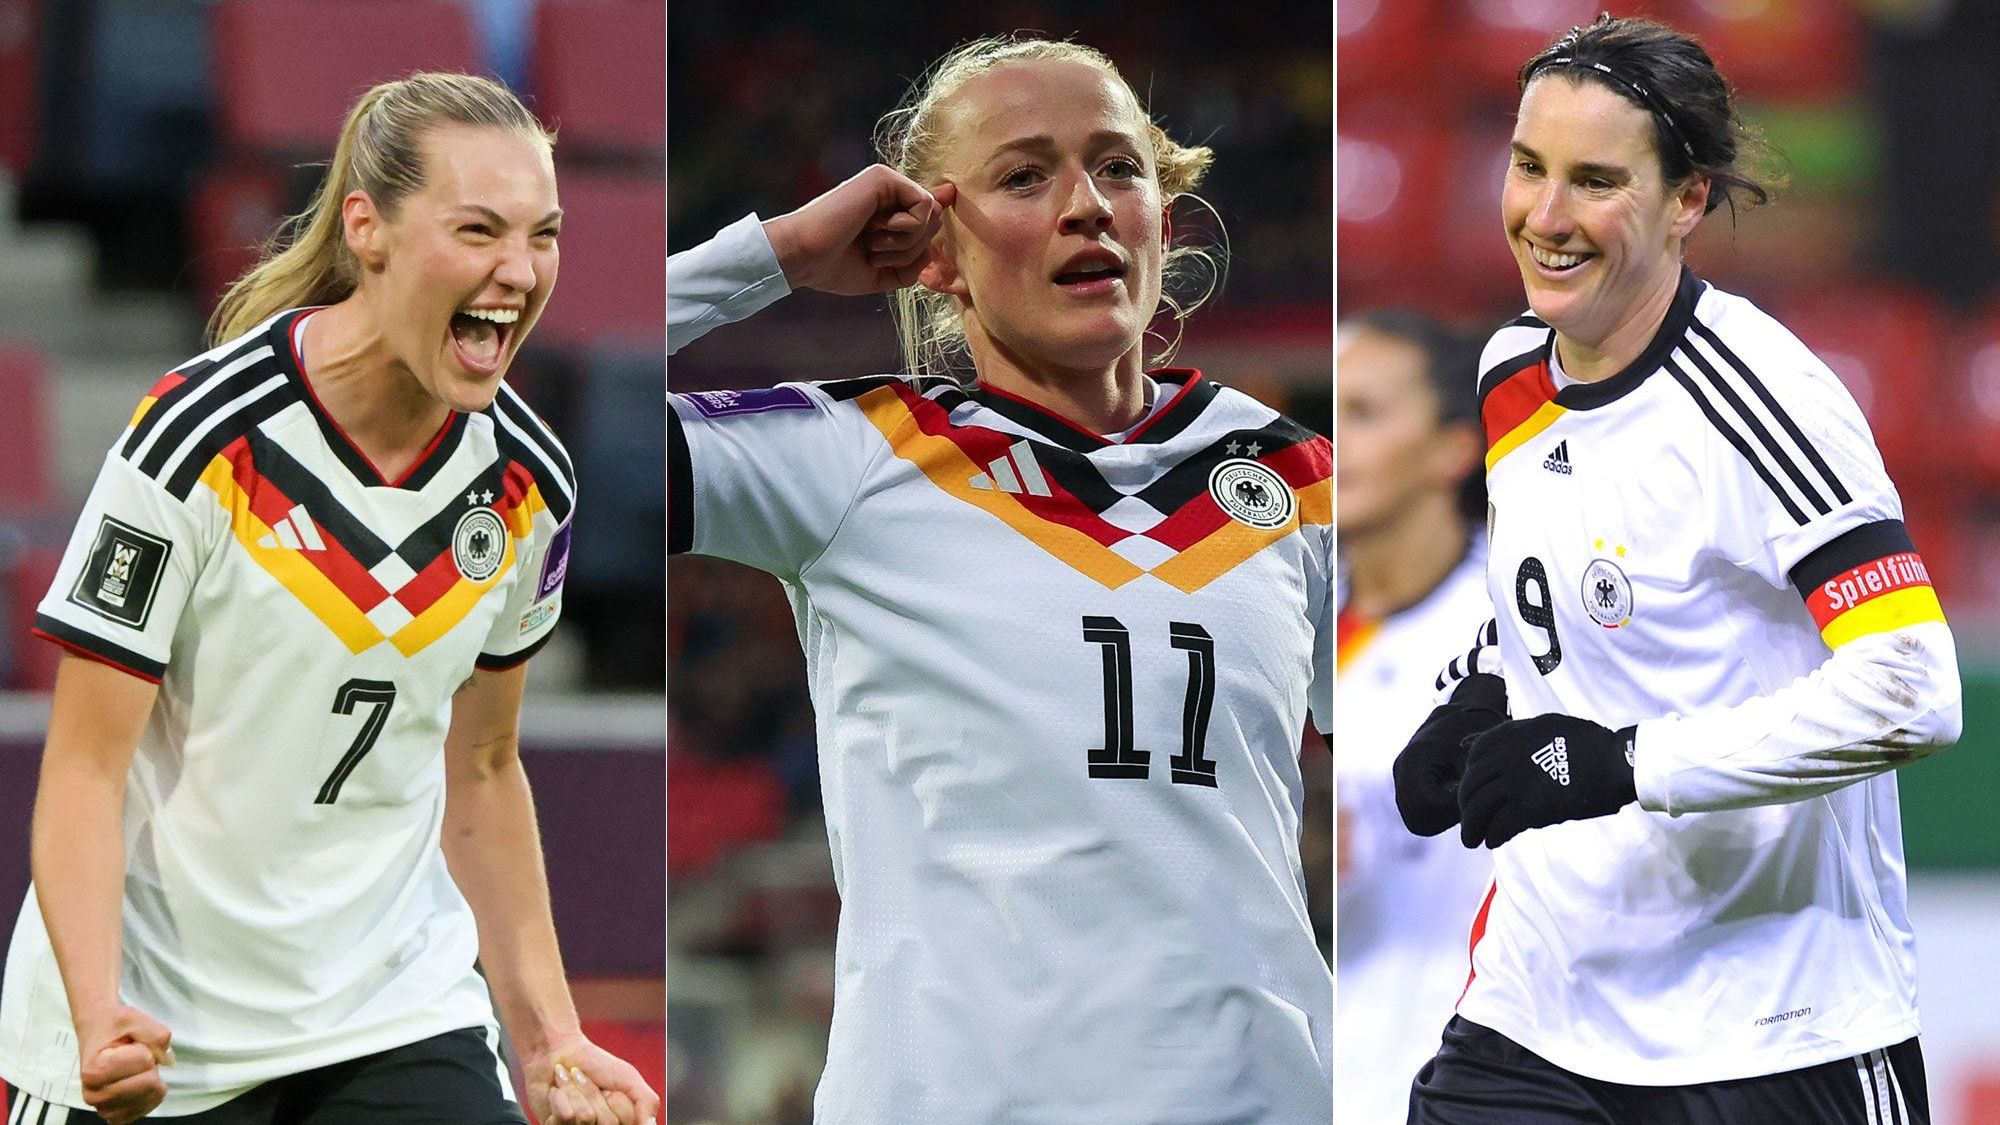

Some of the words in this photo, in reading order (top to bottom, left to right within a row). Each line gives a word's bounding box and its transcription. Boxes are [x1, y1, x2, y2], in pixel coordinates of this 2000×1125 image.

[1225, 470, 1268, 483] DEUTSCHER
[1543, 459, 1572, 475] adidas
[1516, 557, 1561, 676] 9
[314, 679, 396, 804] 7
[1082, 616, 1218, 788] 11
[1554, 736, 1571, 786] adidas
